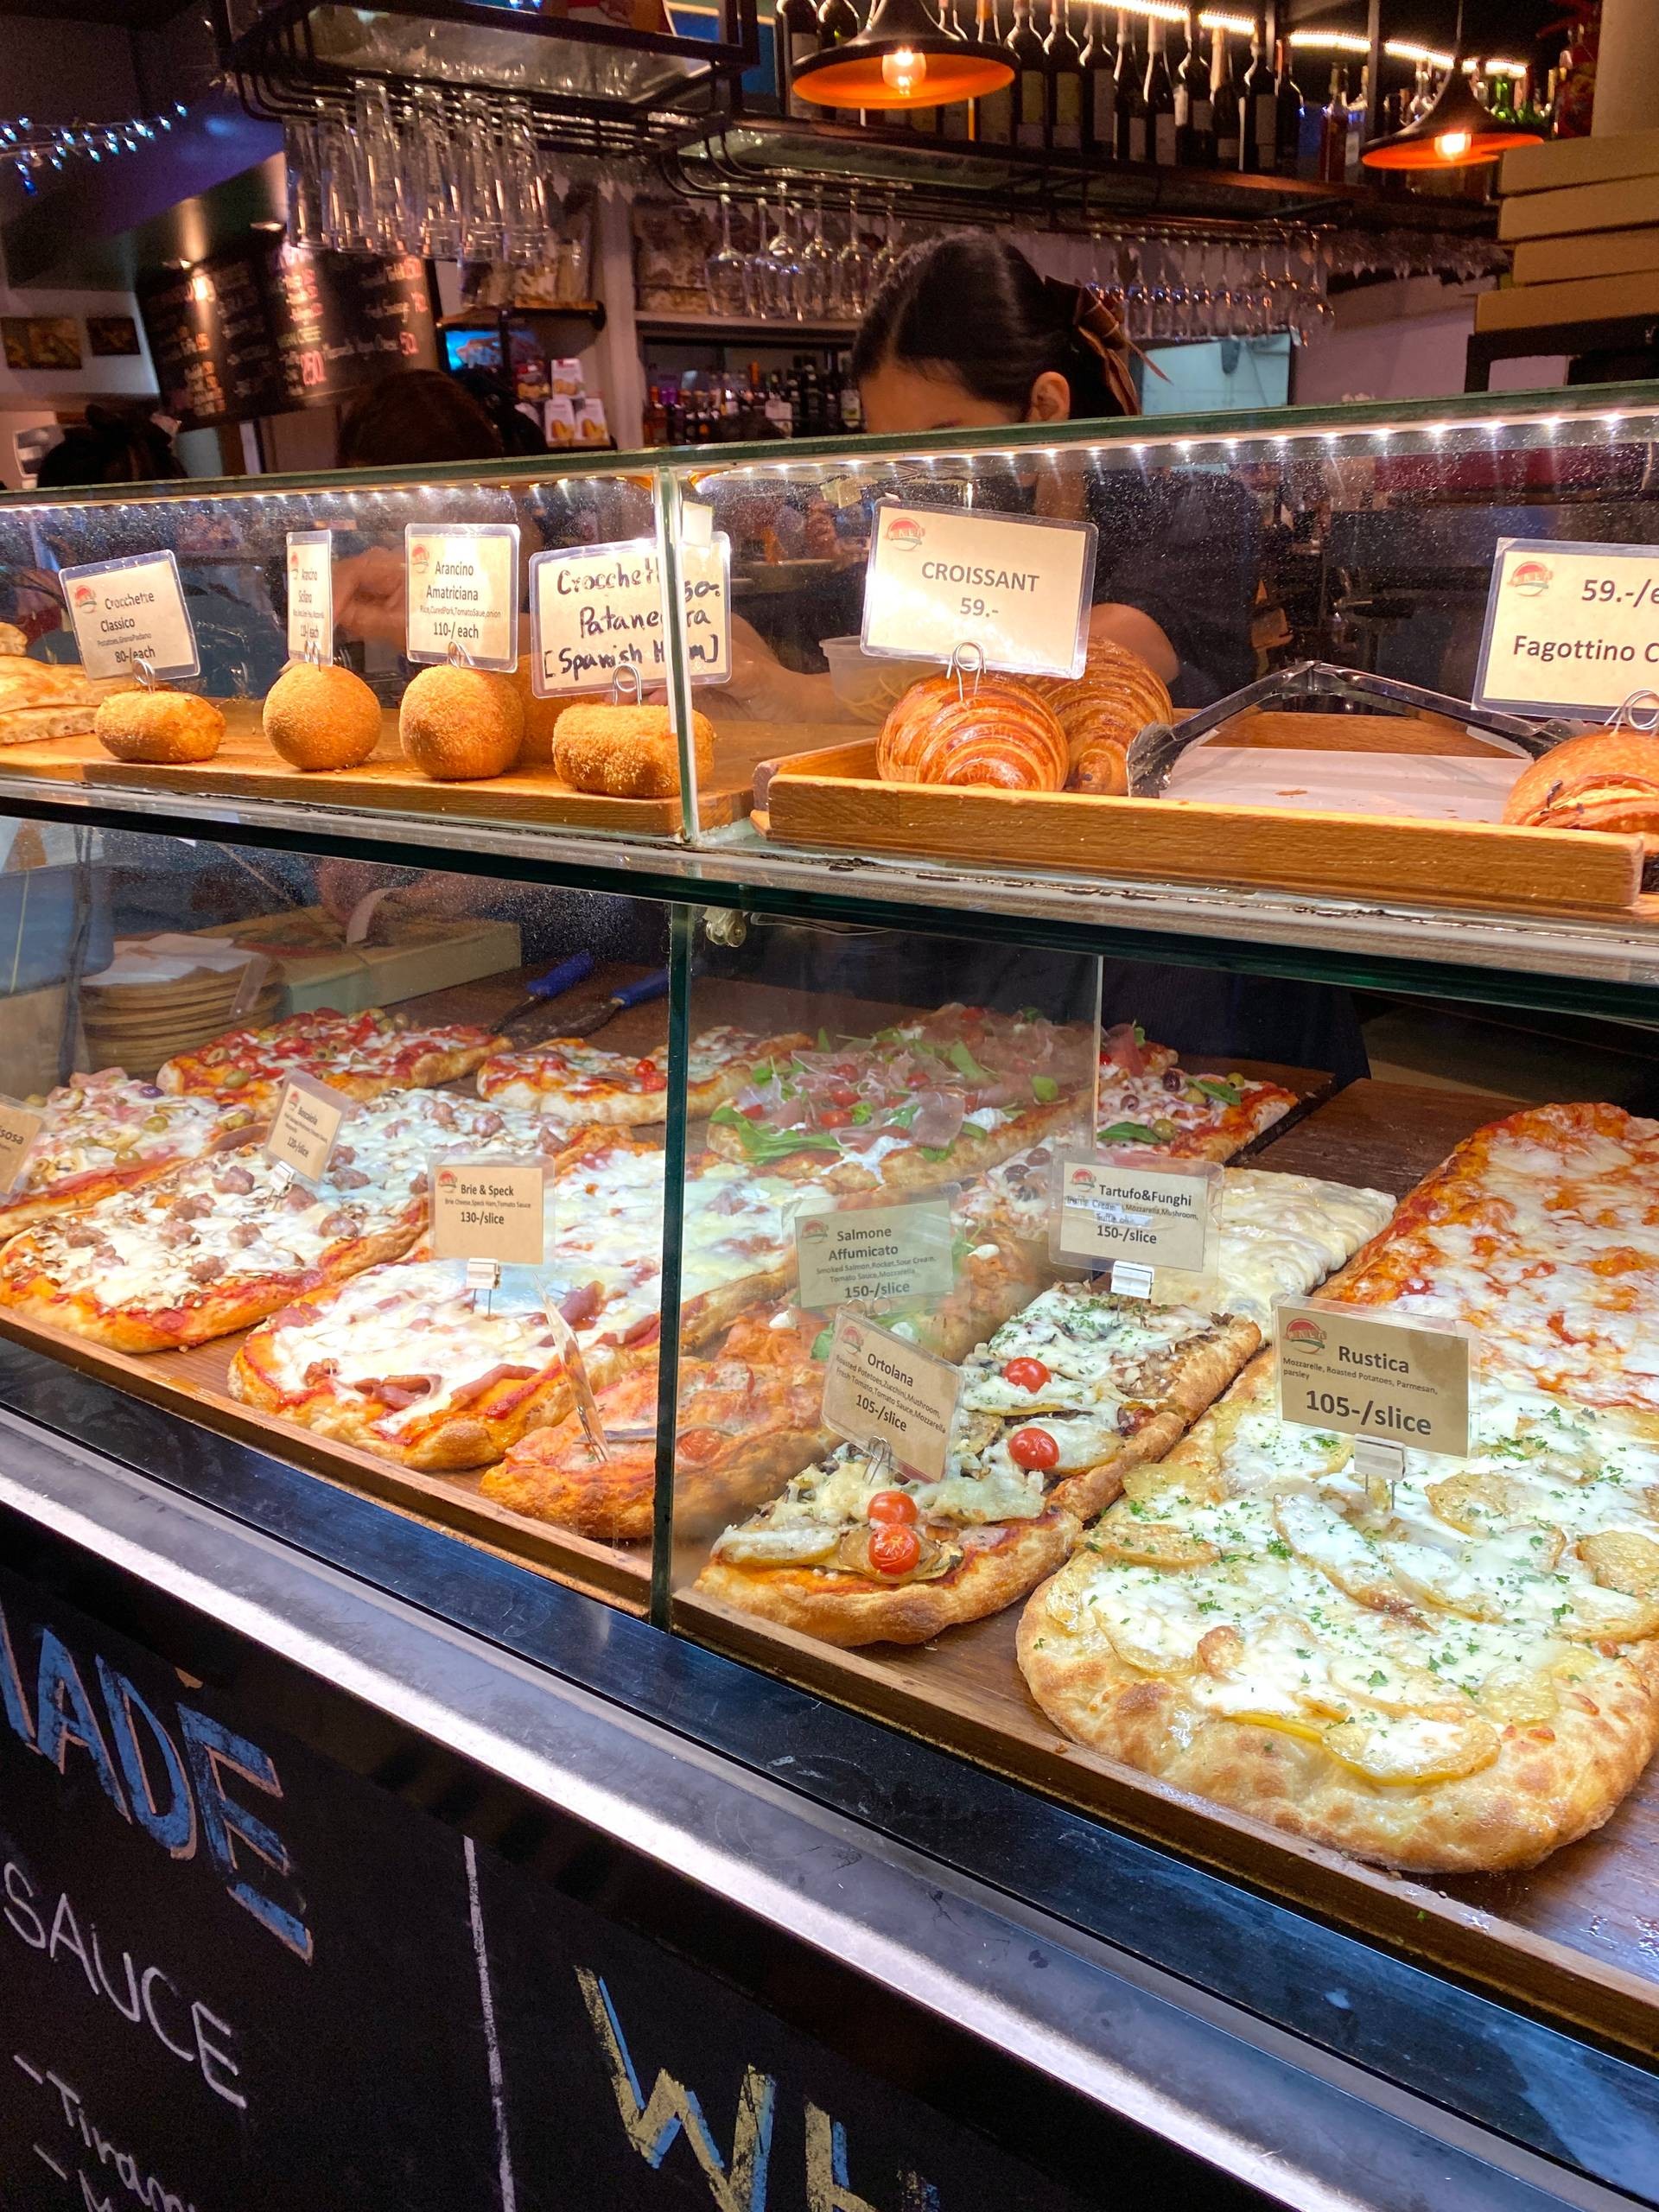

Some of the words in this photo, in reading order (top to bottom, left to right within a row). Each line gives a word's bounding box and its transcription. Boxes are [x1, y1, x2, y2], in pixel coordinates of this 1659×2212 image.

[435, 561, 474, 576] Arancino
[921, 562, 1039, 592] CROISSANT
[105, 592, 155, 610] Crocchette
[426, 584, 479, 601] Amatriciana
[959, 597, 1000, 618] 59.-
[100, 617, 136, 632] Classico
[457, 624, 479, 639] each
[579, 605, 710, 639] Patanera
[114, 645, 156, 664] 80-/each
[653, 632, 719, 665] Hm]
[1514, 635, 1636, 662] Fagottino
[461, 1184, 477, 1195] Brie
[479, 1185, 486, 1195] &
[488, 1185, 514, 1198] Speck
[1099, 1184, 1192, 1207] Tartufo&Funghi
[461, 1211, 505, 1225] 130-/slice
[836, 1227, 892, 1242] Salmone
[1096, 1225, 1157, 1244] 150-/slice
[829, 1244, 899, 1261] Affumicato
[844, 1282, 910, 1299] 150-/slice
[836, 1355, 857, 1371] Roasted
[1338, 1345, 1409, 1374] Rustica
[868, 1353, 913, 1387] Ortolana
[1283, 1369, 1311, 1381] parsley
[1326, 1366, 1357, 1378] Roasted
[1358, 1372, 1395, 1387] Potatoes,
[1396, 1380, 1439, 1395] Parmesan,
[855, 1395, 907, 1432] 105-/slice
[1306, 1390, 1432, 1436] 105-/slice
[3, 1862, 247, 2109] SAUCE
